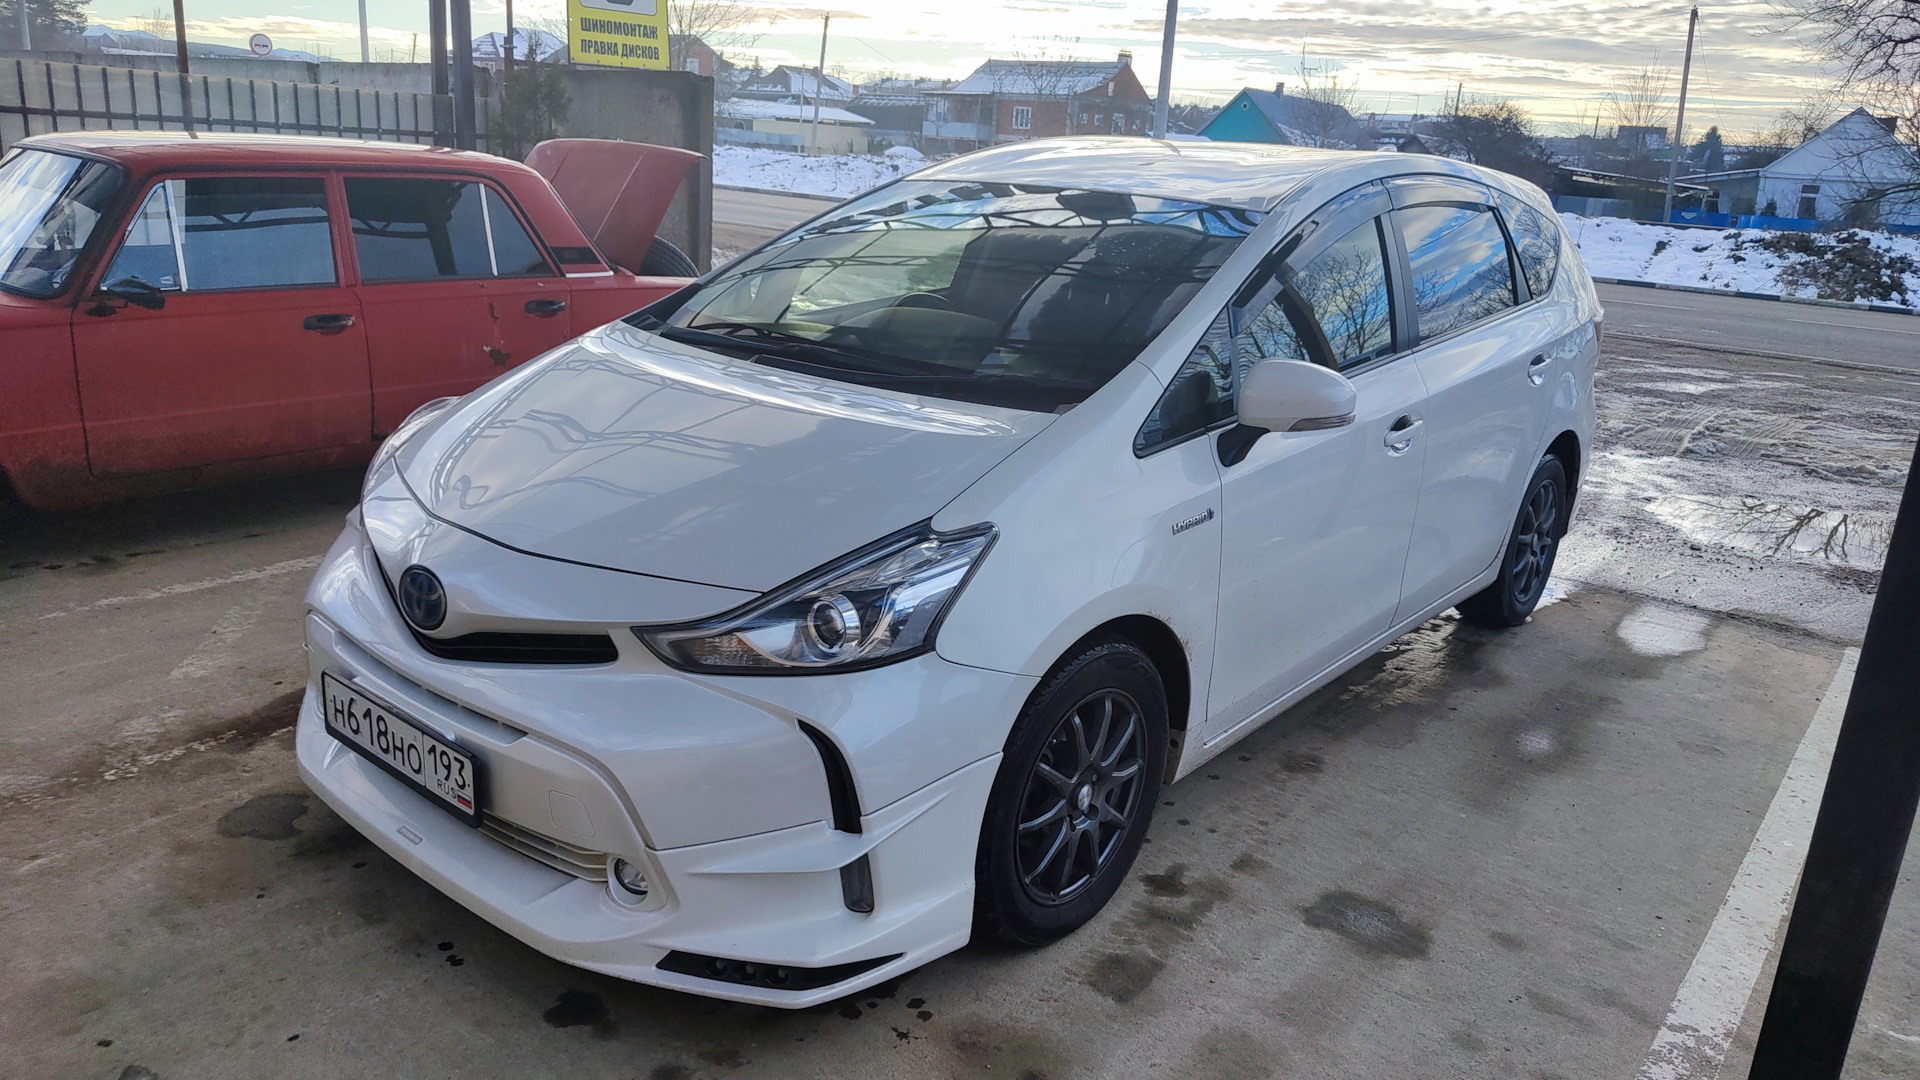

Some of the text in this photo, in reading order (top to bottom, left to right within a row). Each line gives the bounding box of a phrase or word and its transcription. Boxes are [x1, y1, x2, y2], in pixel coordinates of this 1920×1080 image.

[580, 17, 658, 39] ШИНОМОНТАЖ
[580, 39, 660, 60] ПРАВКА ДИСКОВ
[1172, 512, 1209, 536] HYBRID
[427, 744, 466, 790] 193
[437, 779, 457, 799] RUS
